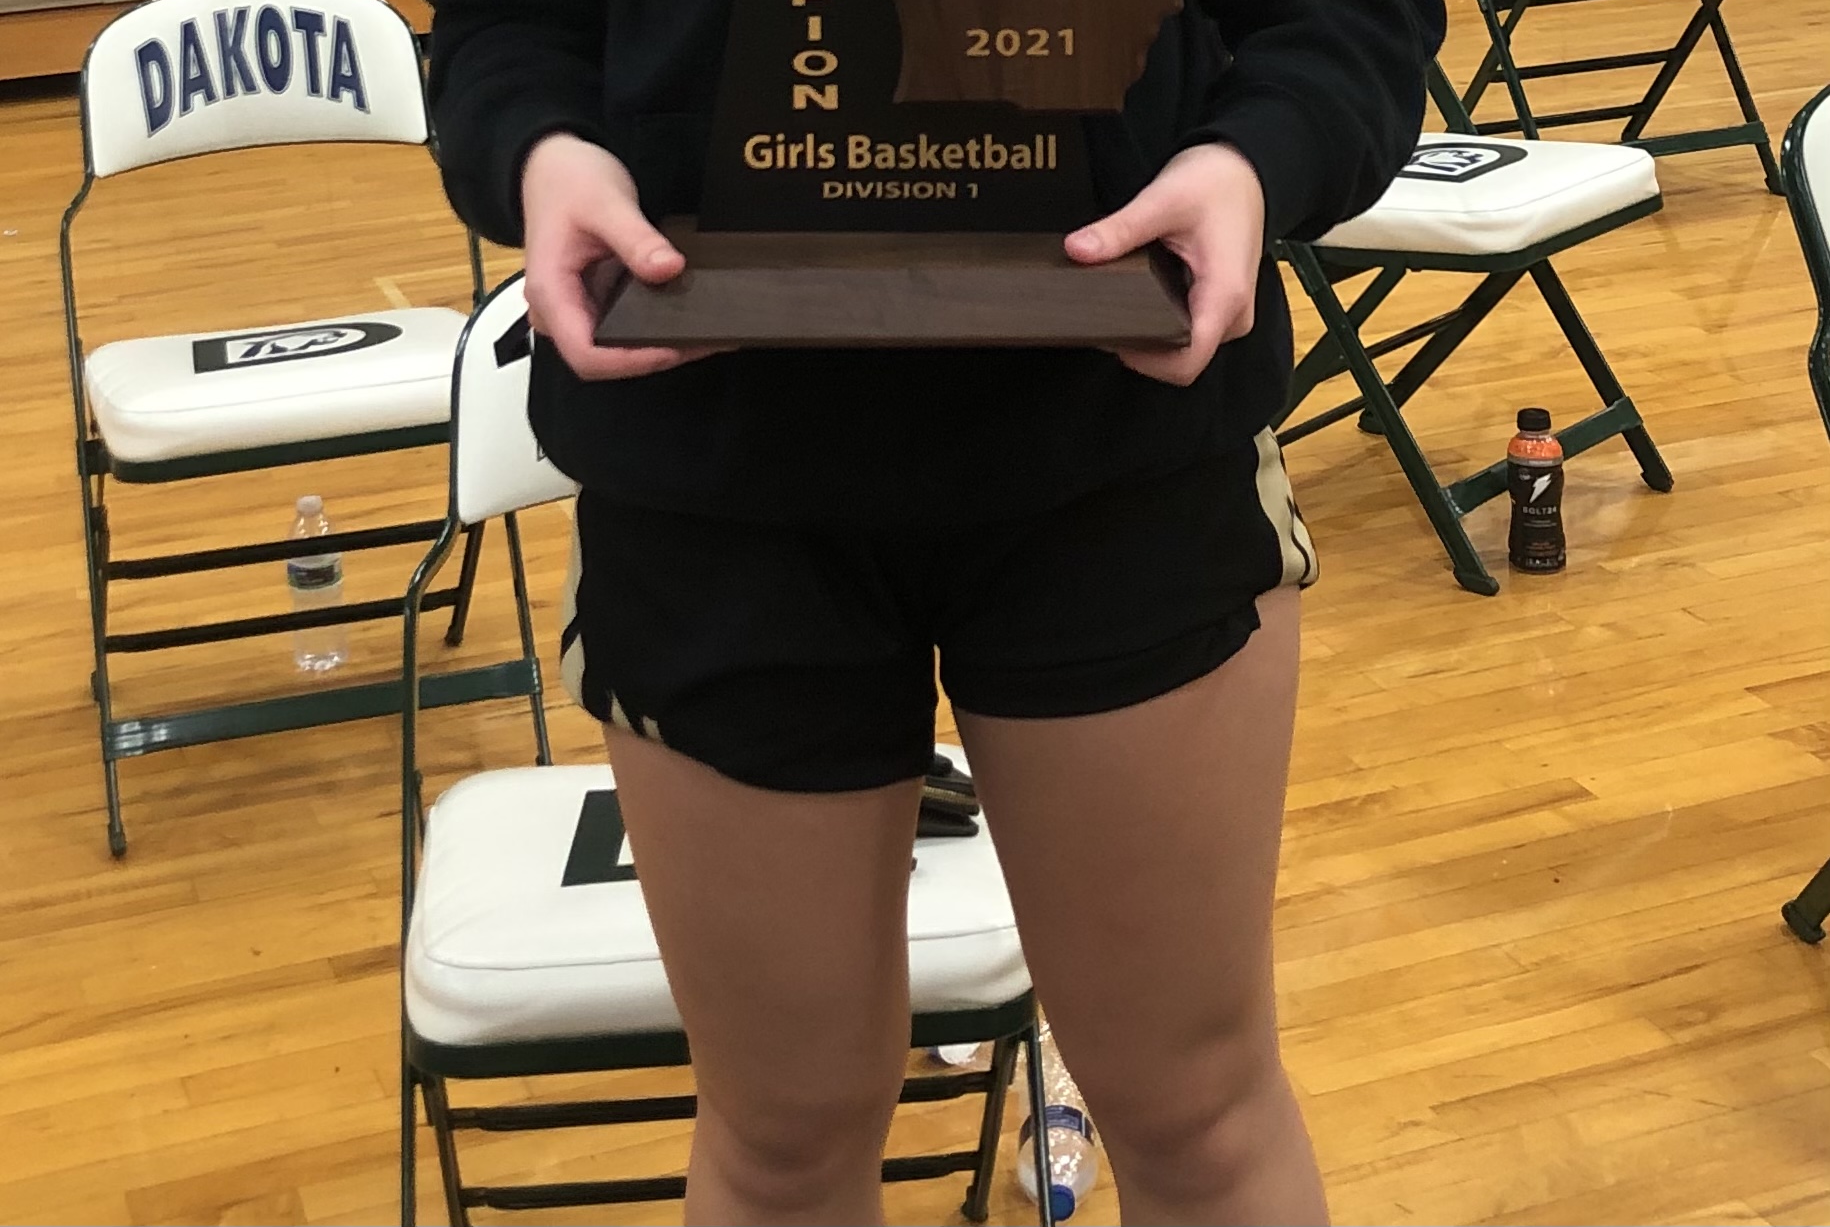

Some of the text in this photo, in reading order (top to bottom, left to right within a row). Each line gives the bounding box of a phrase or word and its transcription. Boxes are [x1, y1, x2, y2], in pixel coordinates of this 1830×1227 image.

[966, 28, 1075, 57] 2021
[134, 5, 370, 137] DAKOTA
[744, 134, 1057, 170] Girls Basketball
[823, 182, 979, 198] DIVISION 1
